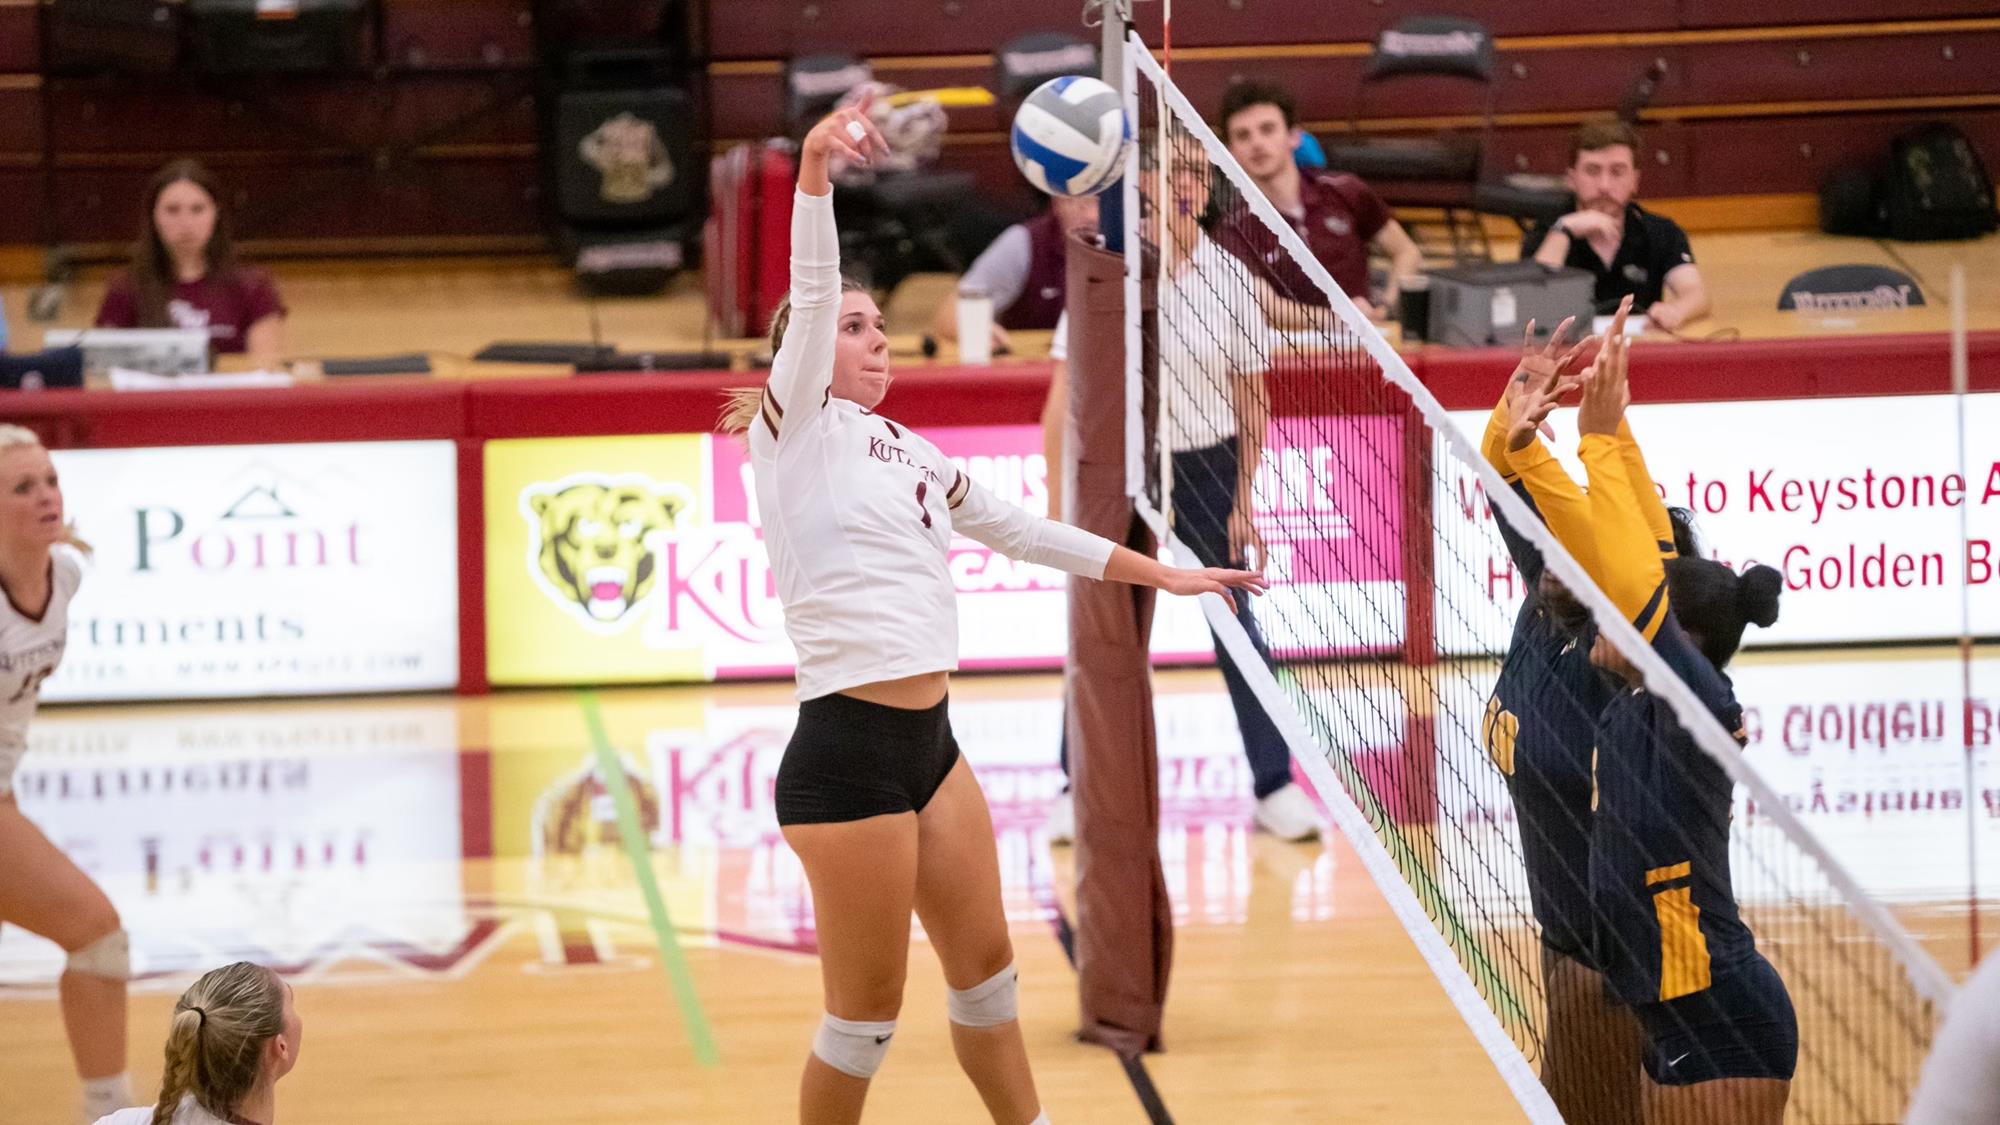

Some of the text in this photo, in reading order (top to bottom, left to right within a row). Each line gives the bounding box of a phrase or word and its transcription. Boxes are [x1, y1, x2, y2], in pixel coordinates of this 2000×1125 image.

[1686, 472, 1727, 514] to
[1748, 467, 1966, 525] Keystone
[133, 506, 363, 574] Point
[1783, 542, 1944, 591] Golden
[1964, 539, 2000, 585] B
